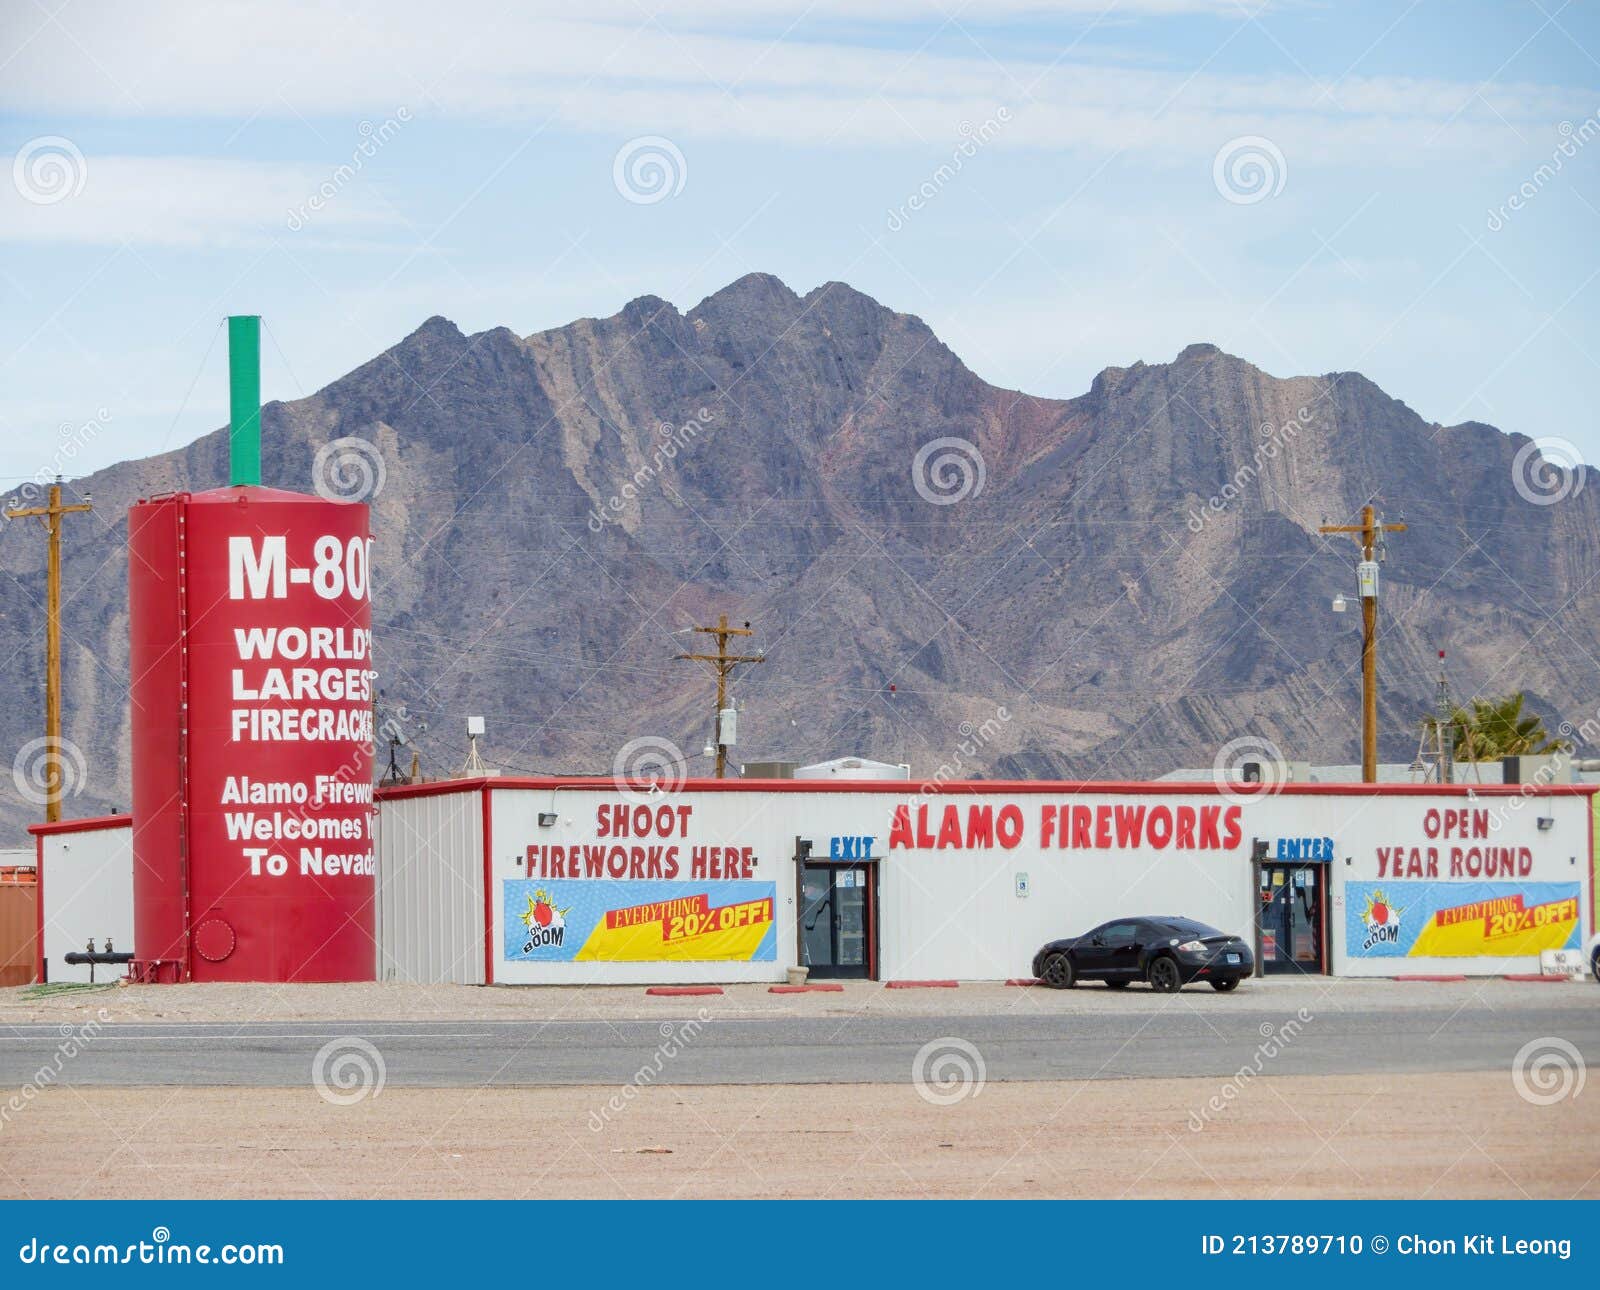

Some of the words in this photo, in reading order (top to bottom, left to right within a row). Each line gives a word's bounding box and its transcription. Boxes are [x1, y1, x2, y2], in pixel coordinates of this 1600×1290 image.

[232, 668, 372, 701] LARGES
[221, 776, 308, 804] Alamo
[315, 775, 373, 804] Firewo
[225, 813, 362, 840] Welcomes
[596, 804, 693, 838] SHOOT
[889, 804, 1024, 850] ALAMO
[1040, 805, 1242, 850] FIREWORKS
[1423, 808, 1489, 839] OPEN
[243, 849, 288, 875] To
[526, 845, 680, 879] FIREWORKS
[691, 846, 753, 879] HERE
[830, 836, 874, 861] EXIT
[1277, 837, 1334, 862] ENTER
[1376, 847, 1439, 878] YEAR
[1451, 847, 1533, 878] ROUND
[615, 896, 701, 928] EVERYTHING
[669, 911, 715, 940] 20%
[719, 901, 769, 930] OFF!
[1443, 896, 1518, 925] EVERYTHING
[1489, 909, 1531, 936] 20%
[1534, 899, 1577, 928] OFF!
[523, 927, 564, 954] BOOM
[530, 924, 542, 936] OH
[1363, 926, 1399, 951] BOOM
[1369, 923, 1379, 934] OH
